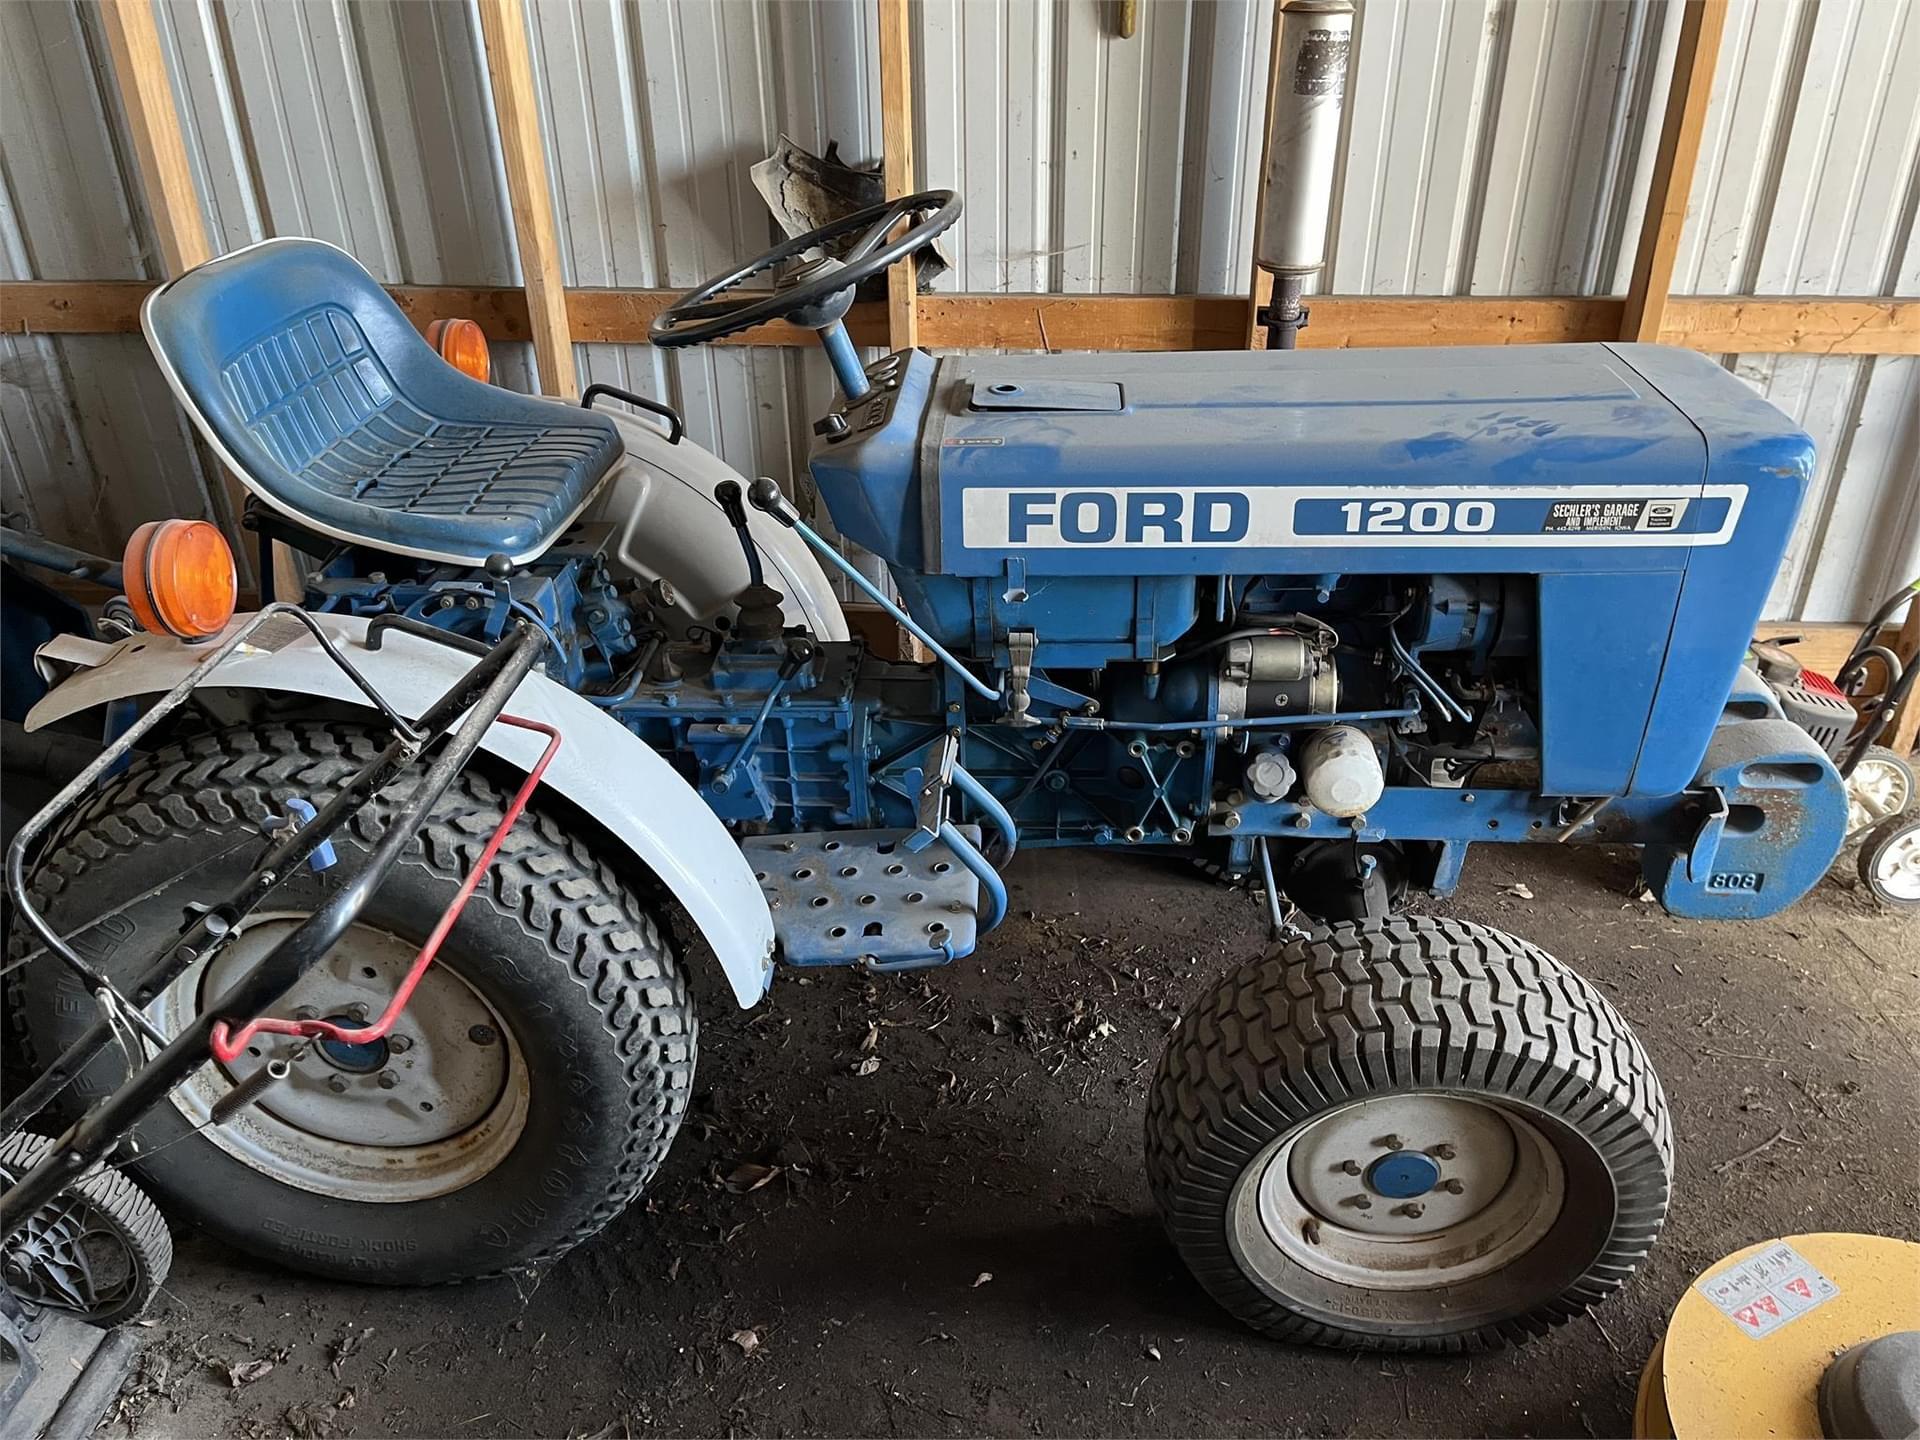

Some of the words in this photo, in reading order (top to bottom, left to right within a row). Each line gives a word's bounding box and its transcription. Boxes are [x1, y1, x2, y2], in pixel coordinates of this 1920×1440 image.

[1008, 492, 1250, 543] FORD
[1340, 501, 1496, 533] 1200
[1553, 503, 1600, 518] SECHLER'S
[1604, 503, 1640, 517] GARAGE
[1565, 516, 1581, 527] AND
[1584, 516, 1623, 527] IMPLEMENT
[1712, 872, 1756, 889] 808
[359, 1238, 419, 1253] SHOCK
